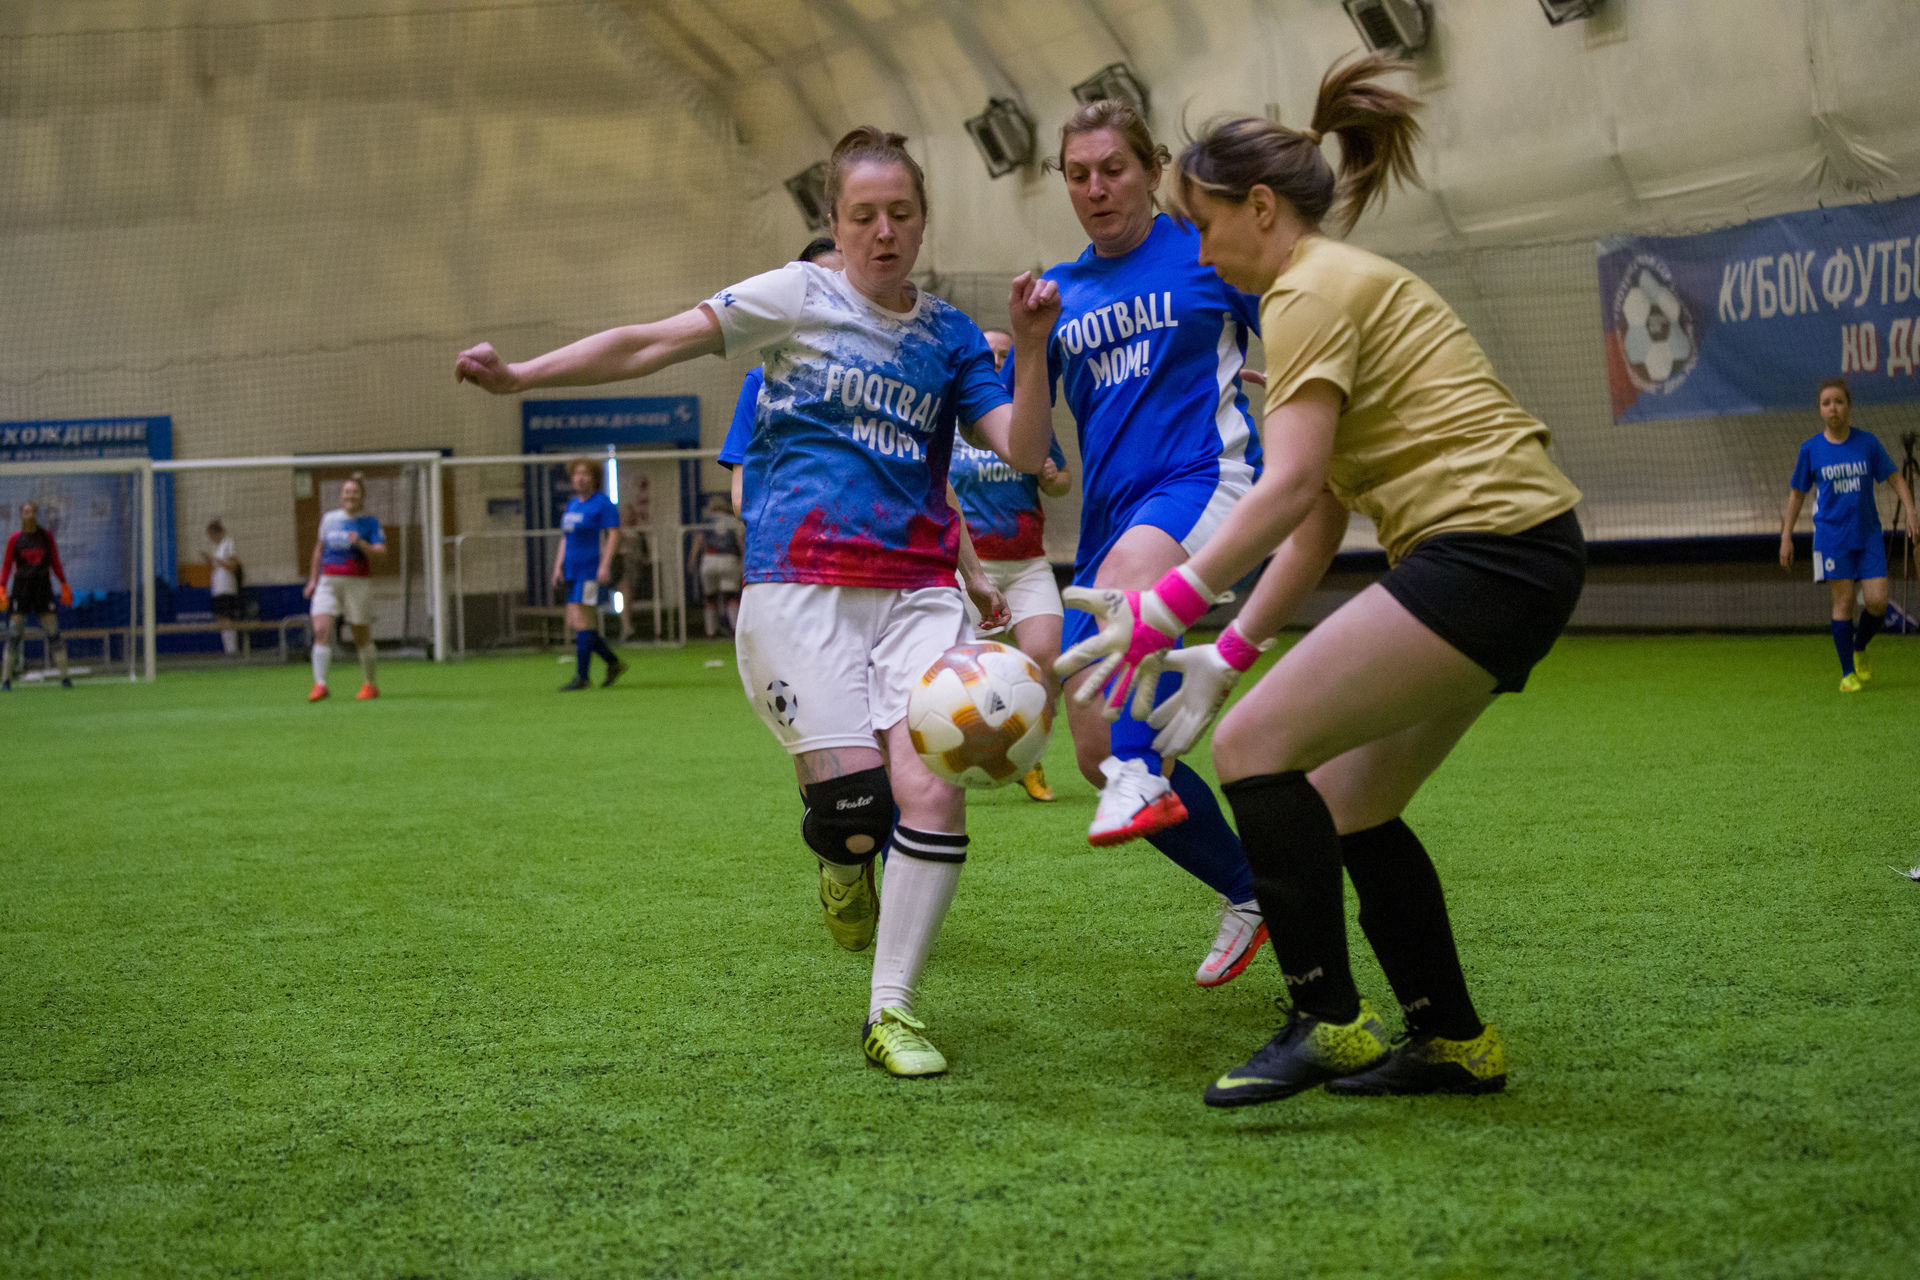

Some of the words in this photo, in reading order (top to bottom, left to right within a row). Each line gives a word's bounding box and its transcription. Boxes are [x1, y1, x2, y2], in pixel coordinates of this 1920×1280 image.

[1718, 249, 1819, 323] КУБОК
[1057, 291, 1179, 360] FOOTBALL
[1840, 321, 1880, 375] НО
[1087, 339, 1151, 391] MOM!
[823, 364, 941, 433] FOOTBAL
[0, 421, 148, 446] ХОЖДЕНИЕ
